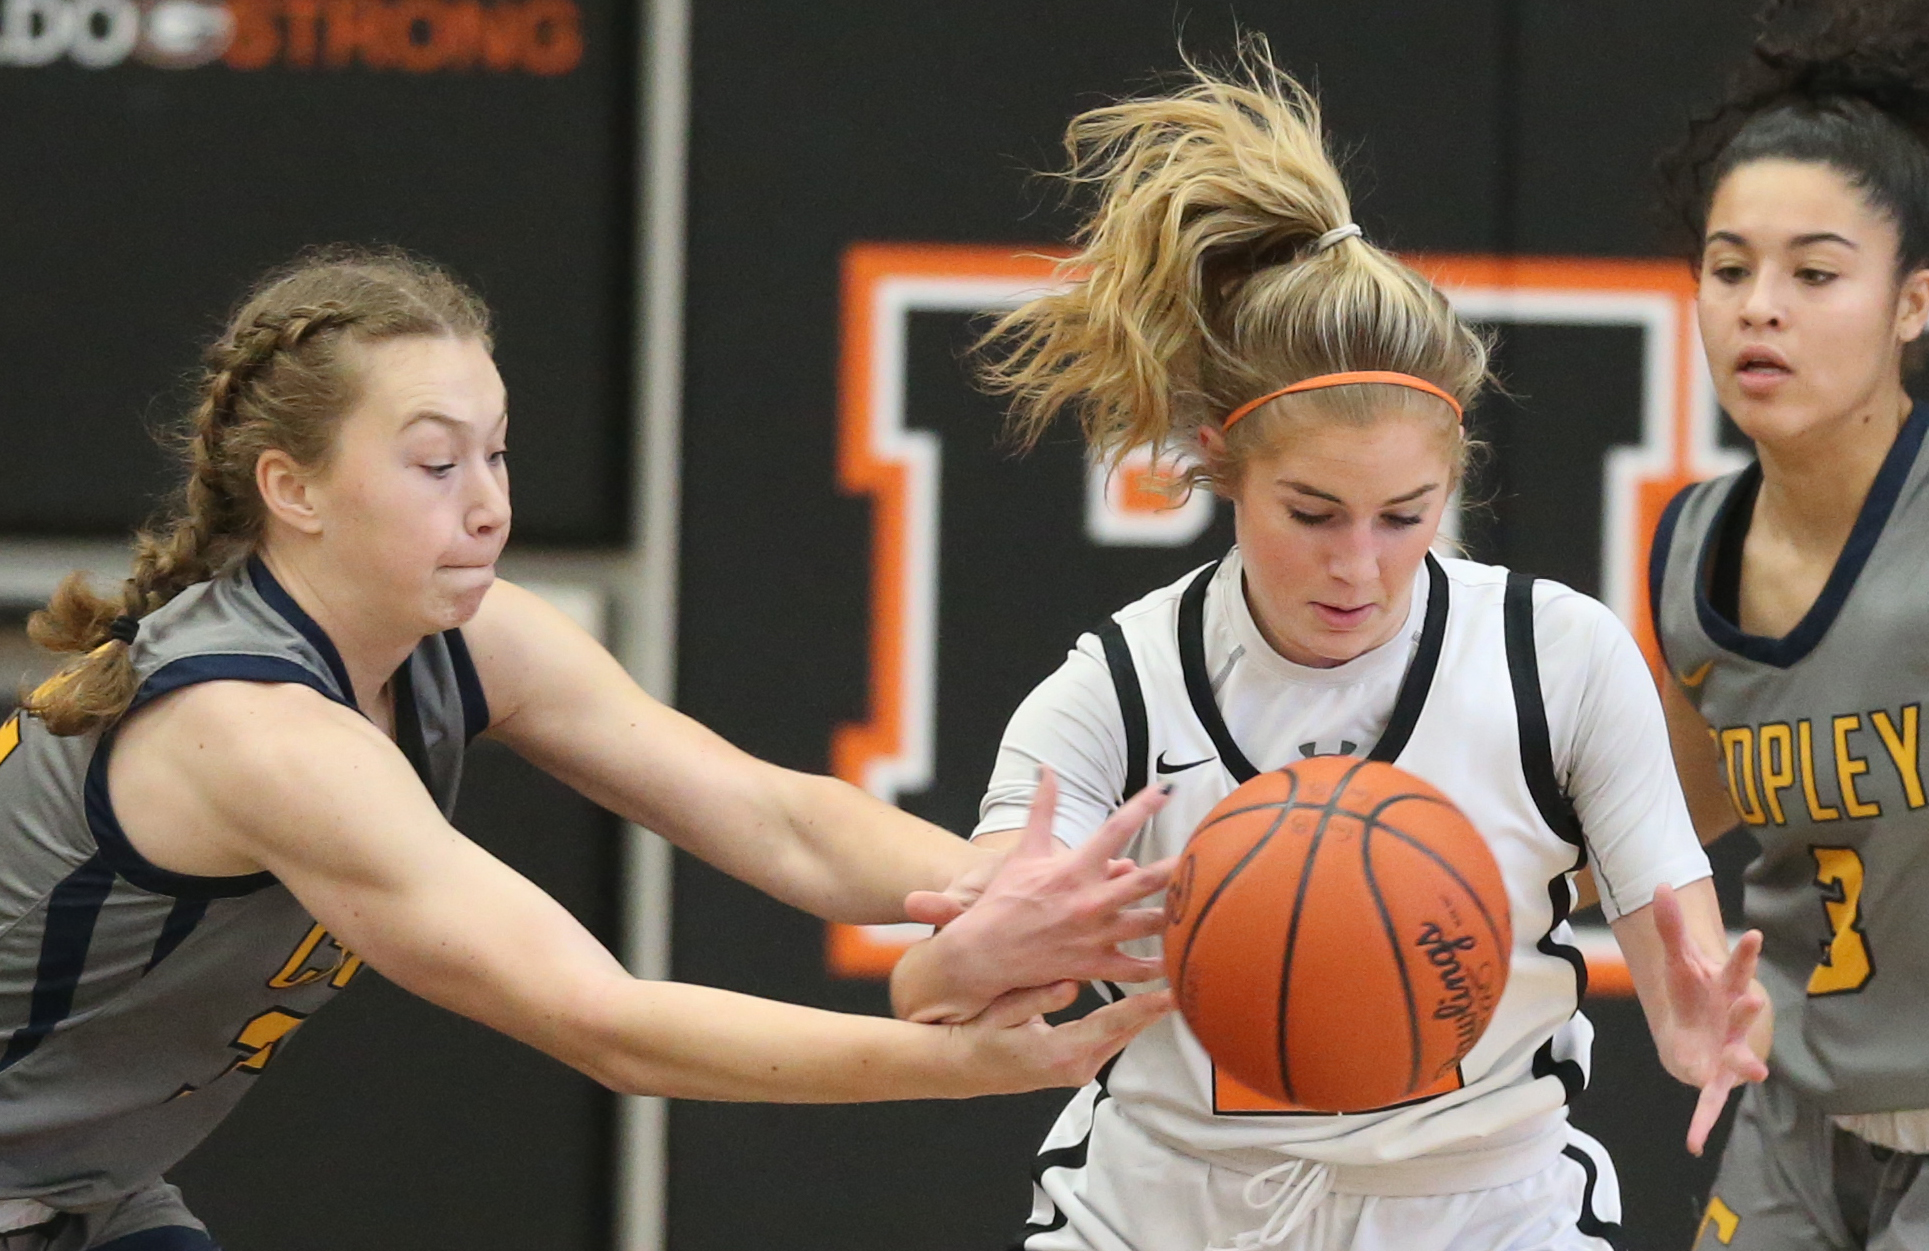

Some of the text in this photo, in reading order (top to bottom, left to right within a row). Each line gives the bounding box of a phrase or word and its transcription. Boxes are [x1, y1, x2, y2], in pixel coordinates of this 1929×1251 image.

[0, 0, 583, 75] DO STRONG
[1708, 702, 1928, 827] OPLEY
